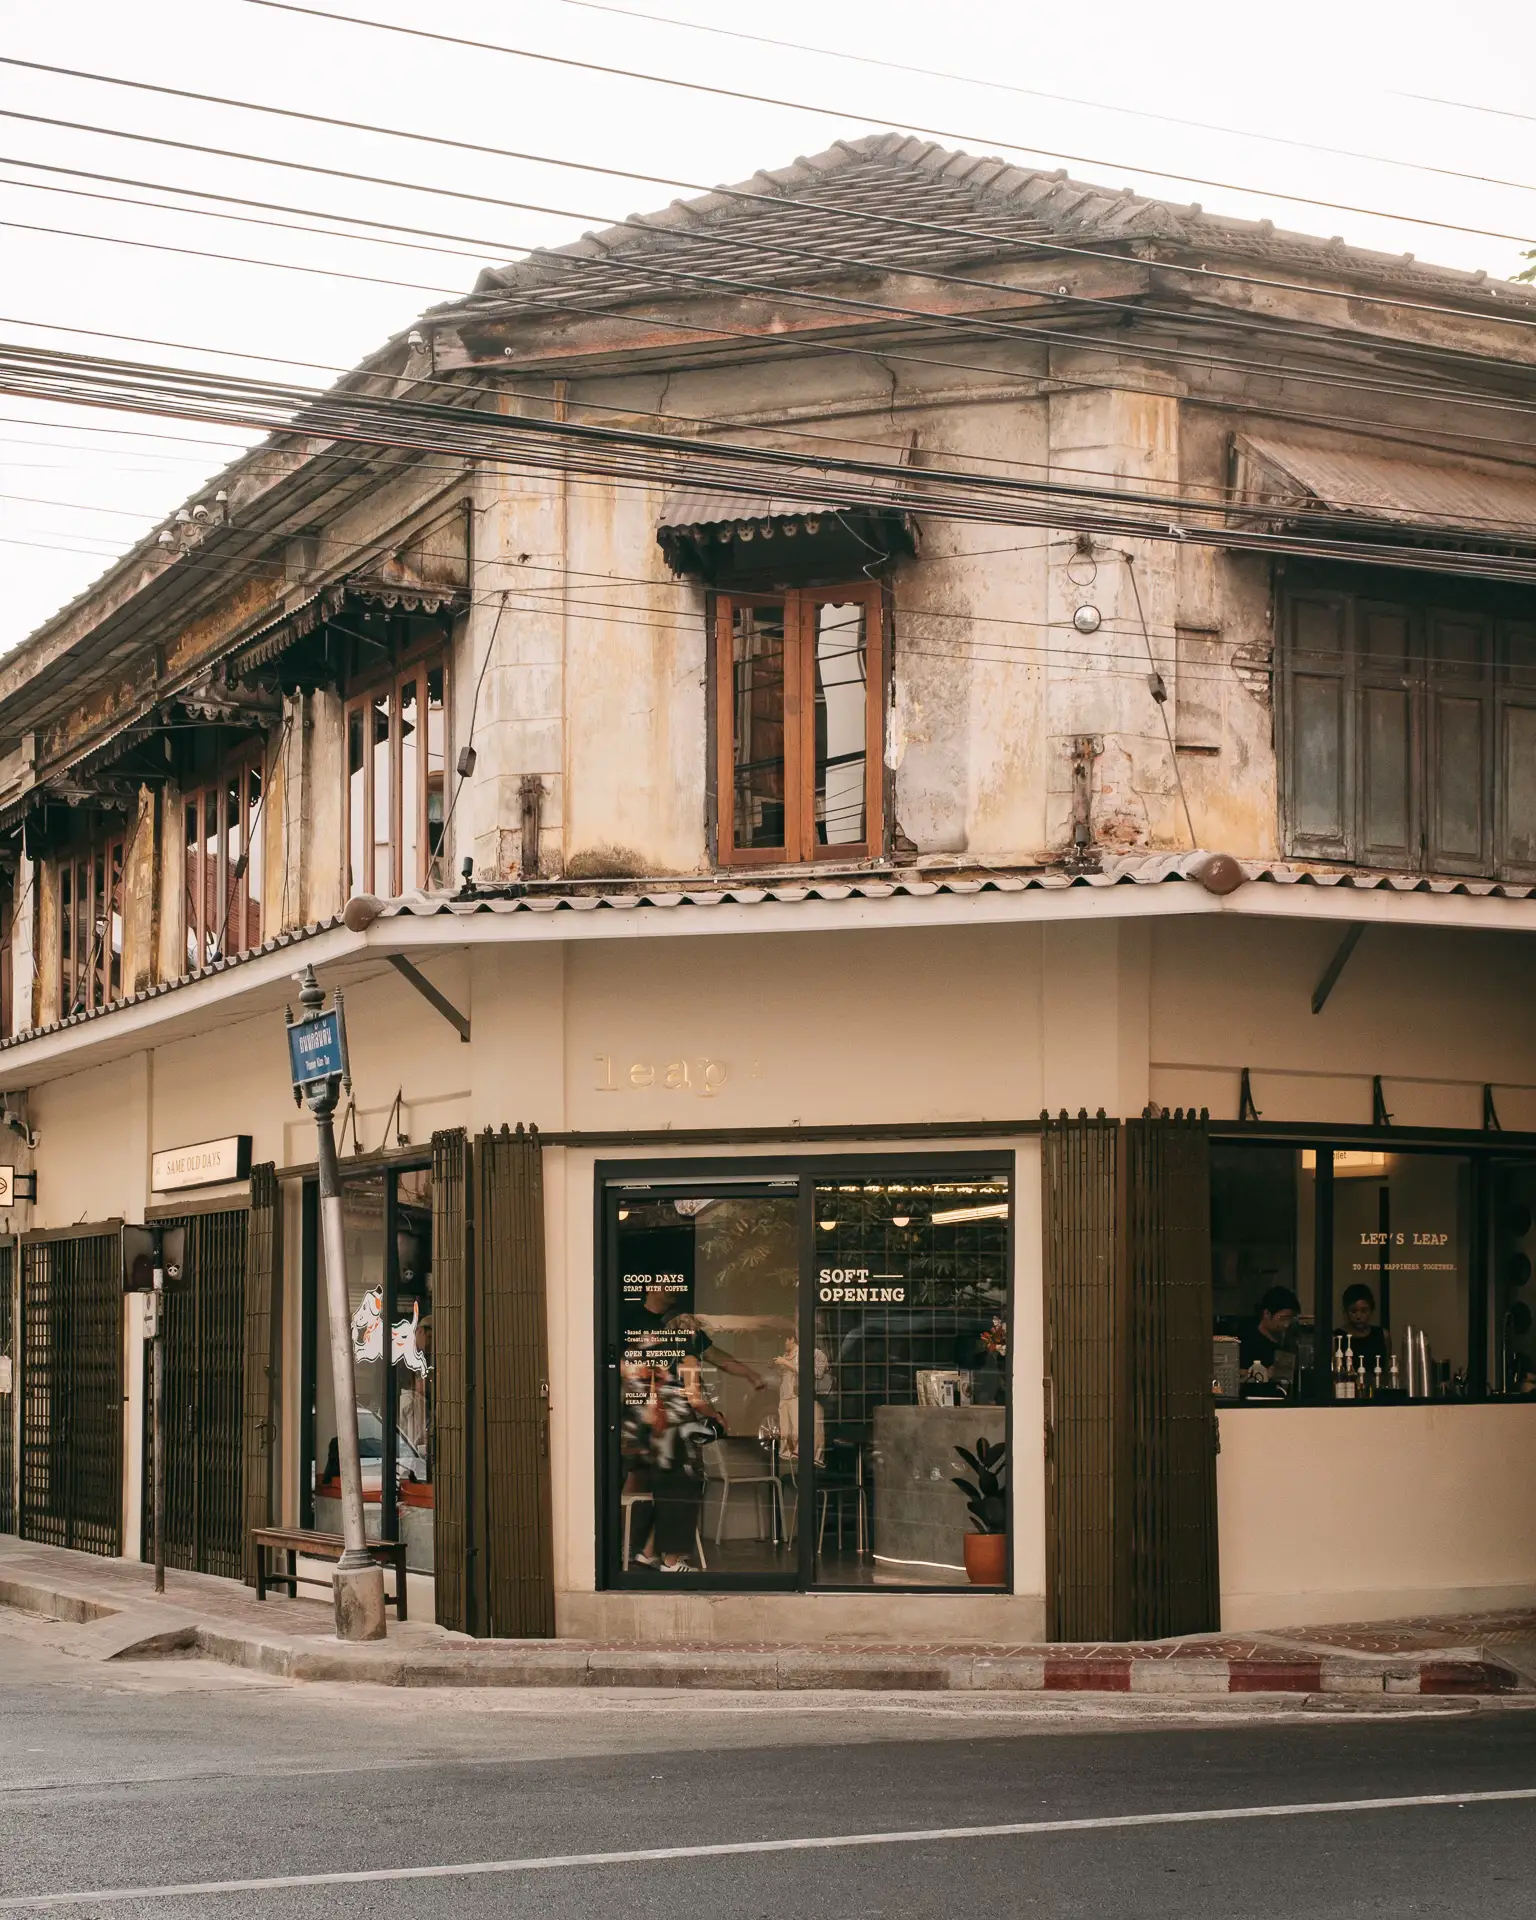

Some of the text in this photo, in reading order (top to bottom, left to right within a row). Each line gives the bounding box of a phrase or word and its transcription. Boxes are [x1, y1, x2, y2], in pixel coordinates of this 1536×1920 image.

[595, 1053, 728, 1098] leap
[167, 1158, 185, 1175] SAME
[187, 1155, 201, 1171] OLD
[202, 1151, 221, 1168] DAYS
[1360, 1233, 1448, 1245] LET'S LEAP
[623, 1274, 684, 1283] GOOD DAYS
[820, 1269, 869, 1283] SOFT
[820, 1288, 905, 1302] OPENING
[624, 1359, 668, 1367] 8:30-17:30
